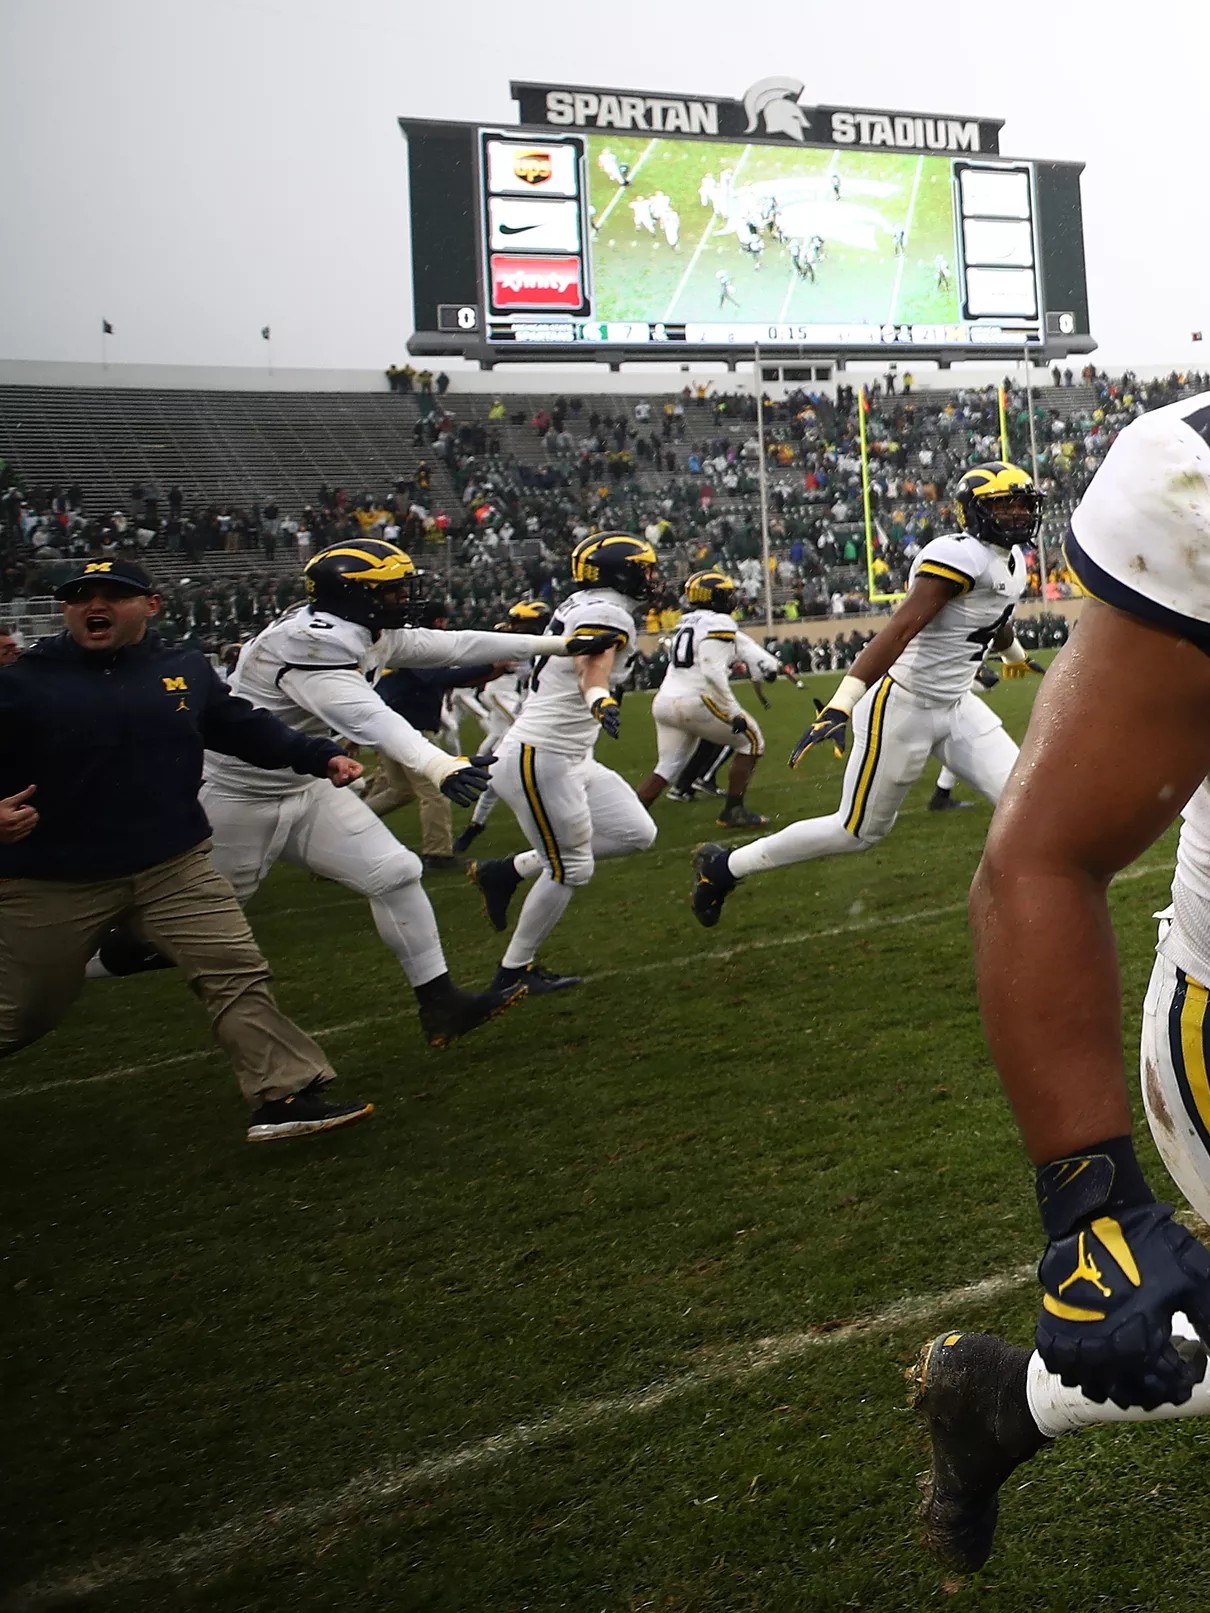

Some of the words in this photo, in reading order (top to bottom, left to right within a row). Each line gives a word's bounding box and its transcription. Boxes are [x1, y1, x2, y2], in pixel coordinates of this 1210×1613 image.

[546, 90, 719, 135] SPARTAN
[831, 112, 980, 152] STADIUM
[501, 269, 572, 293] xfinity
[768, 326, 807, 340] 0:15
[84, 562, 114, 574] M
[162, 676, 188, 691] M
